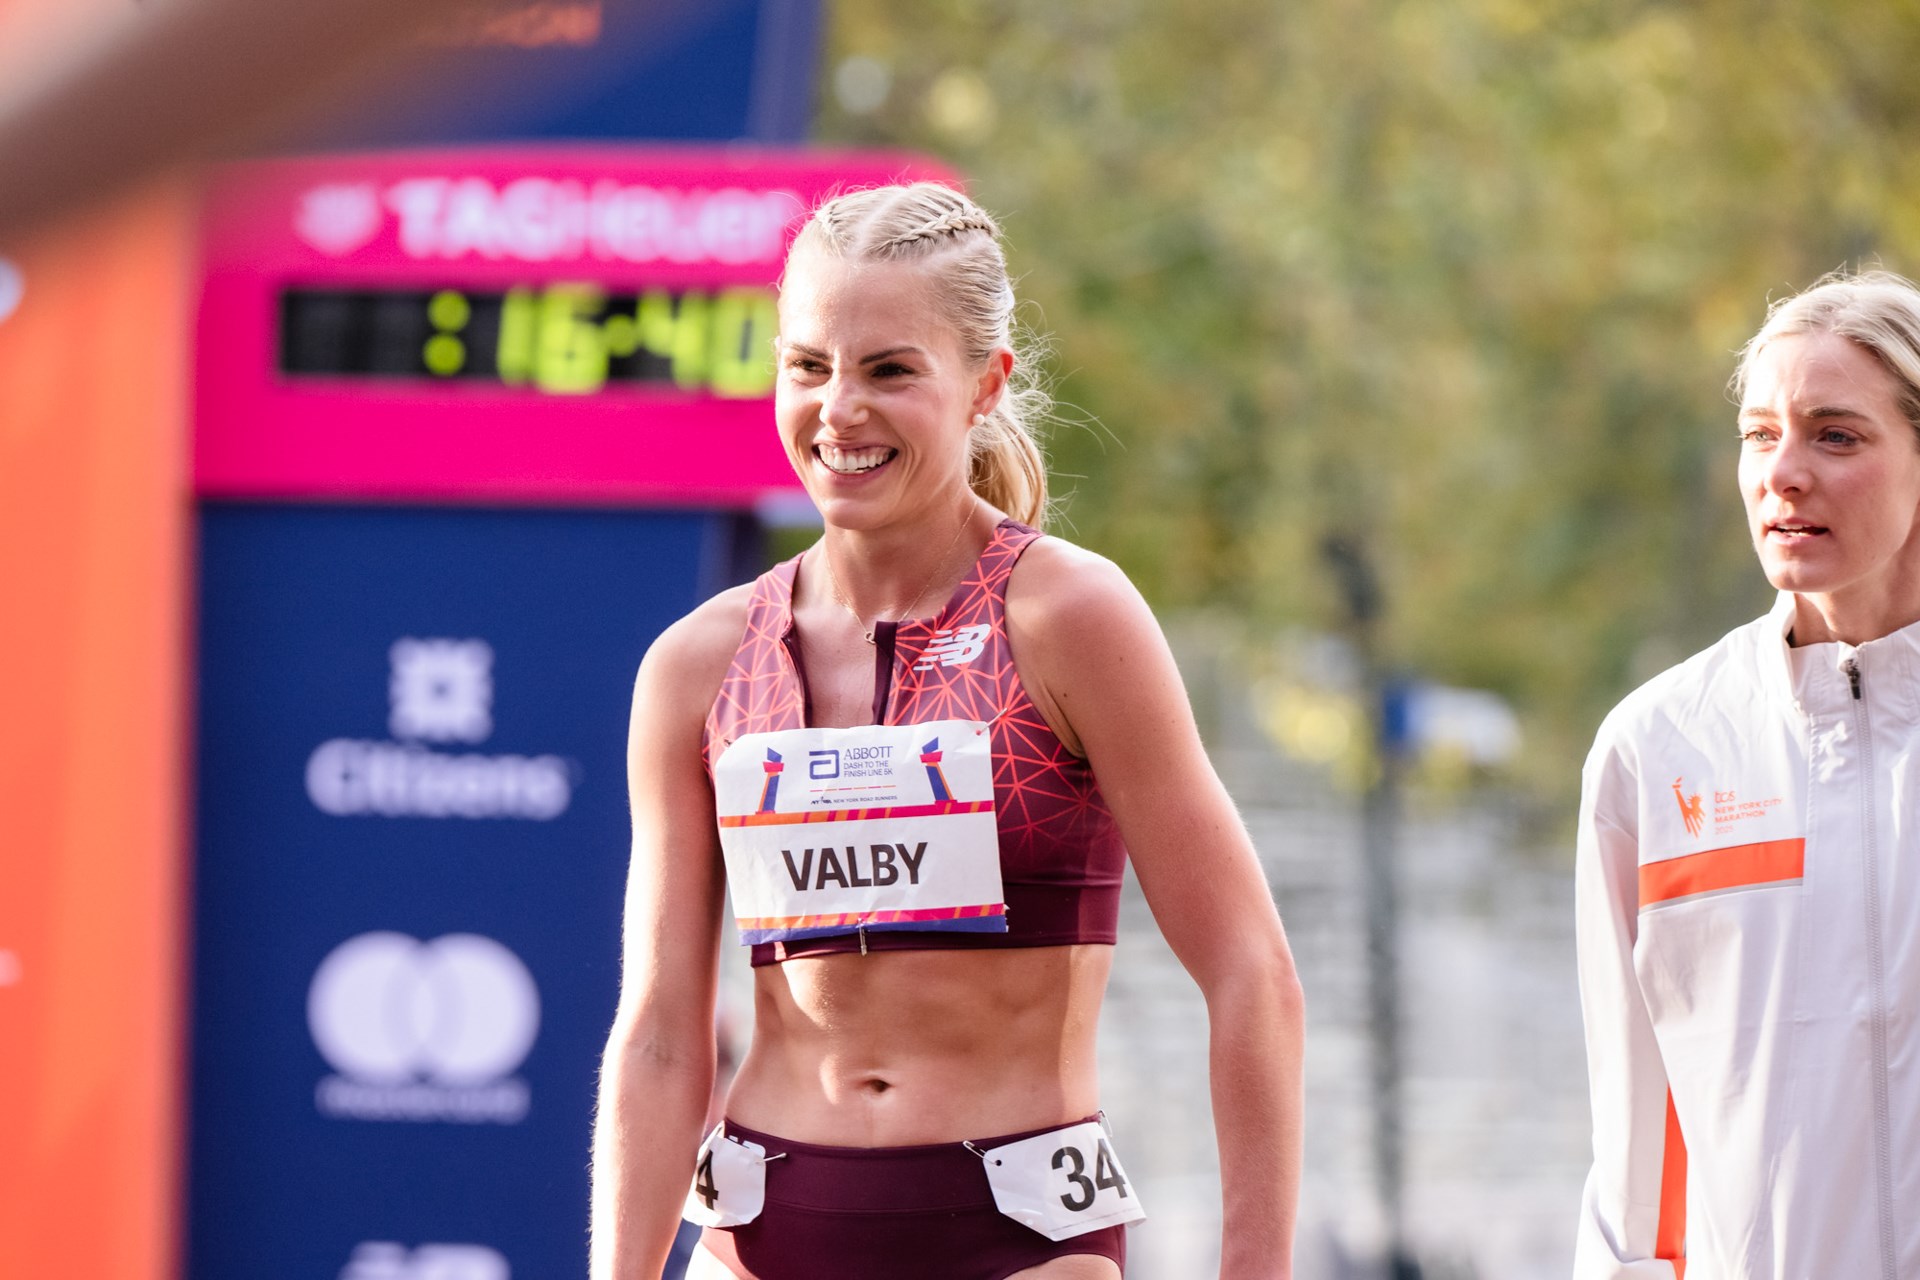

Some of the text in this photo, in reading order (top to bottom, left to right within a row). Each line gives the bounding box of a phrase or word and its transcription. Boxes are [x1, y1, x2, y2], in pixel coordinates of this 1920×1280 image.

[843, 745, 894, 761] ABBOTT
[843, 760, 889, 770] DASH TO THE
[843, 768, 894, 778] FINISH LINE 5K
[1714, 798, 1782, 815] NEW YORK CITY
[1714, 809, 1766, 824] MARATHON
[781, 841, 929, 892] VALBY
[1051, 1138, 1128, 1212] 34
